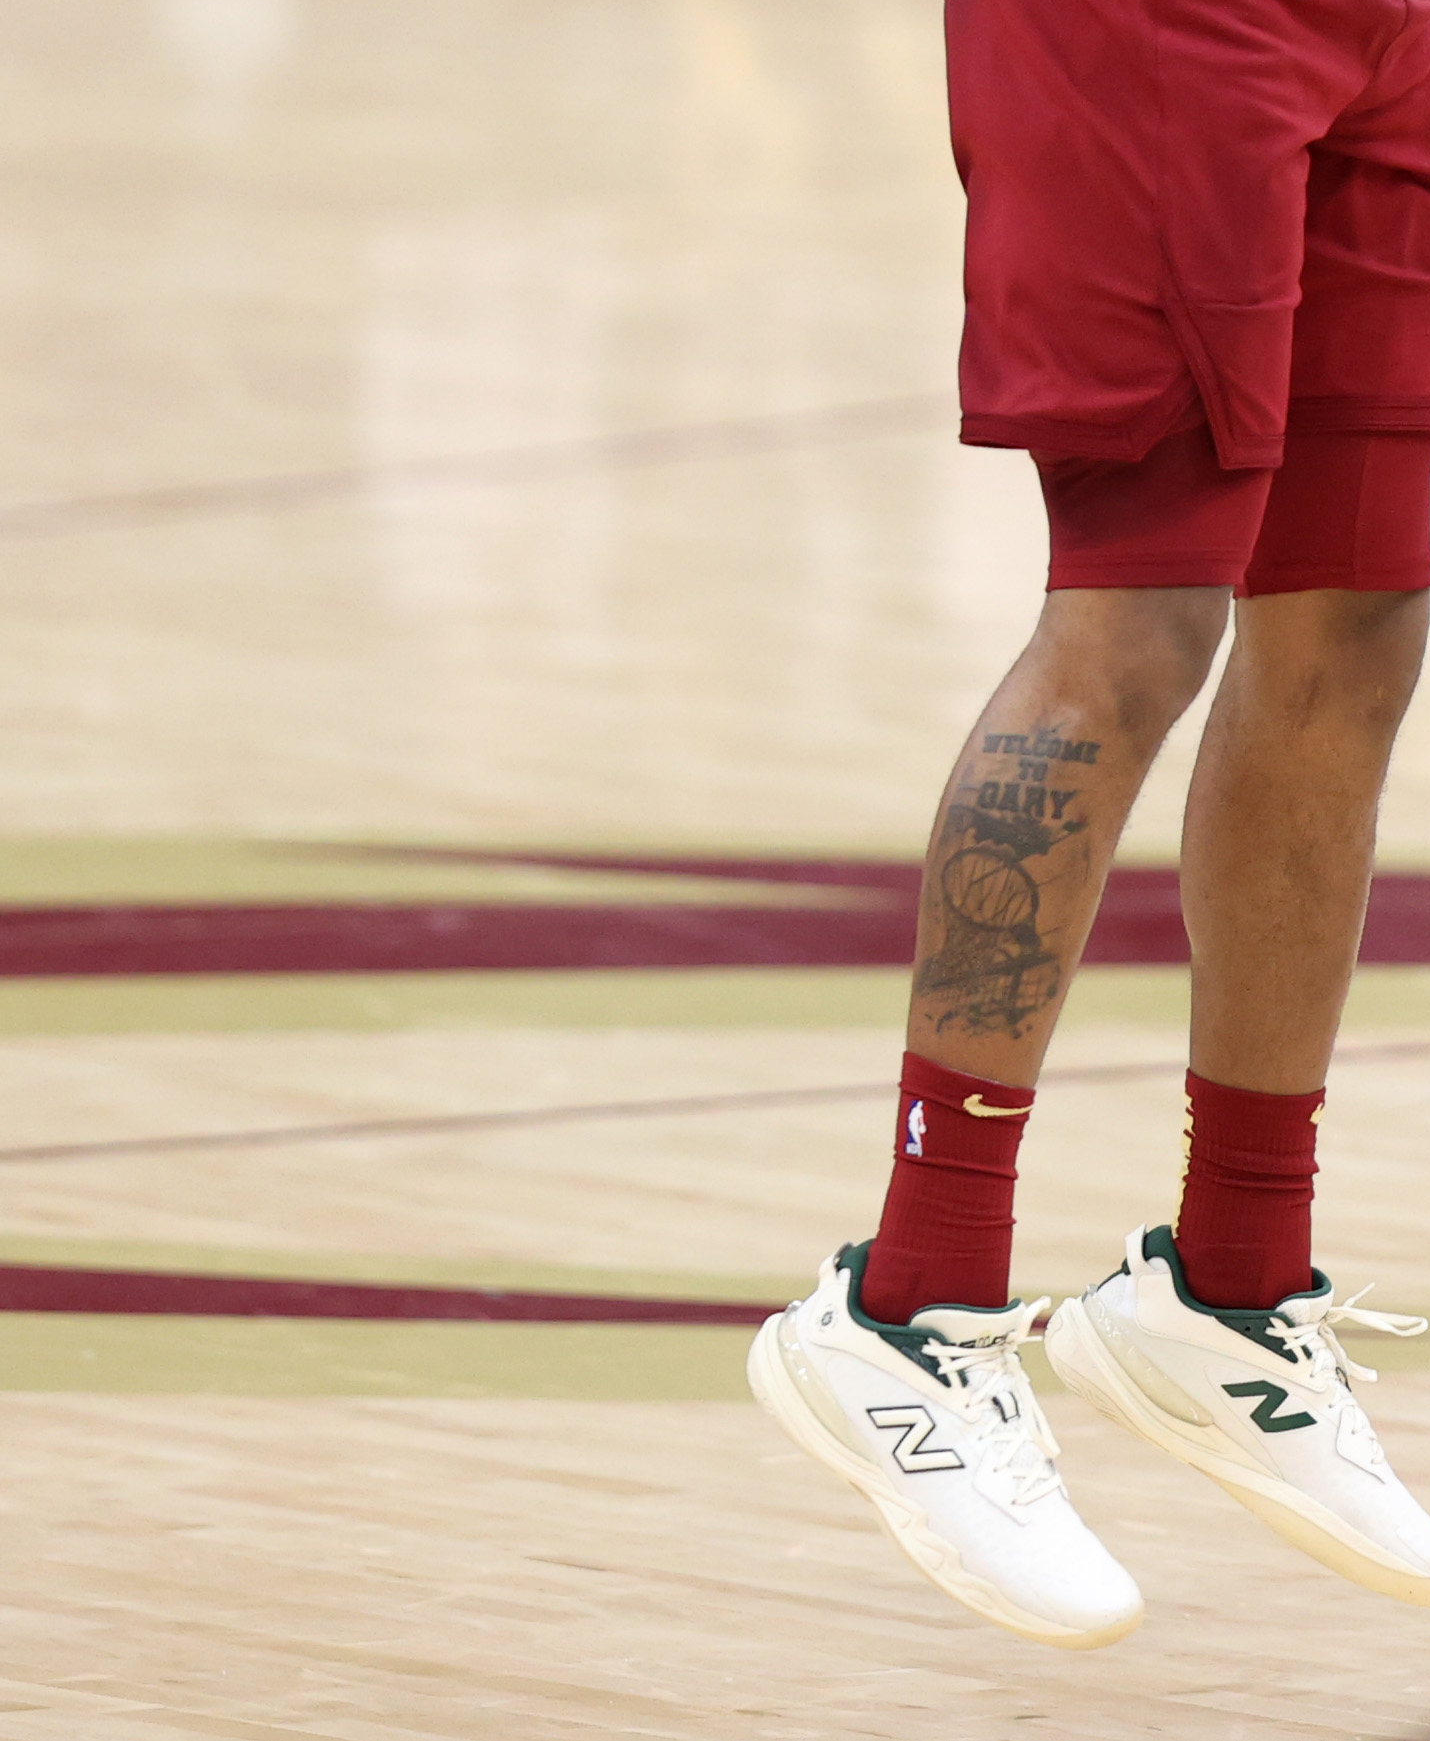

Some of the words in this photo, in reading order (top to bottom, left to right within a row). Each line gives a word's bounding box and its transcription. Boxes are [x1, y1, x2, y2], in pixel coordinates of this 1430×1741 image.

[982, 733, 1102, 765] WELCOME
[1018, 759, 1048, 782] TO
[978, 781, 1079, 820] GARY
